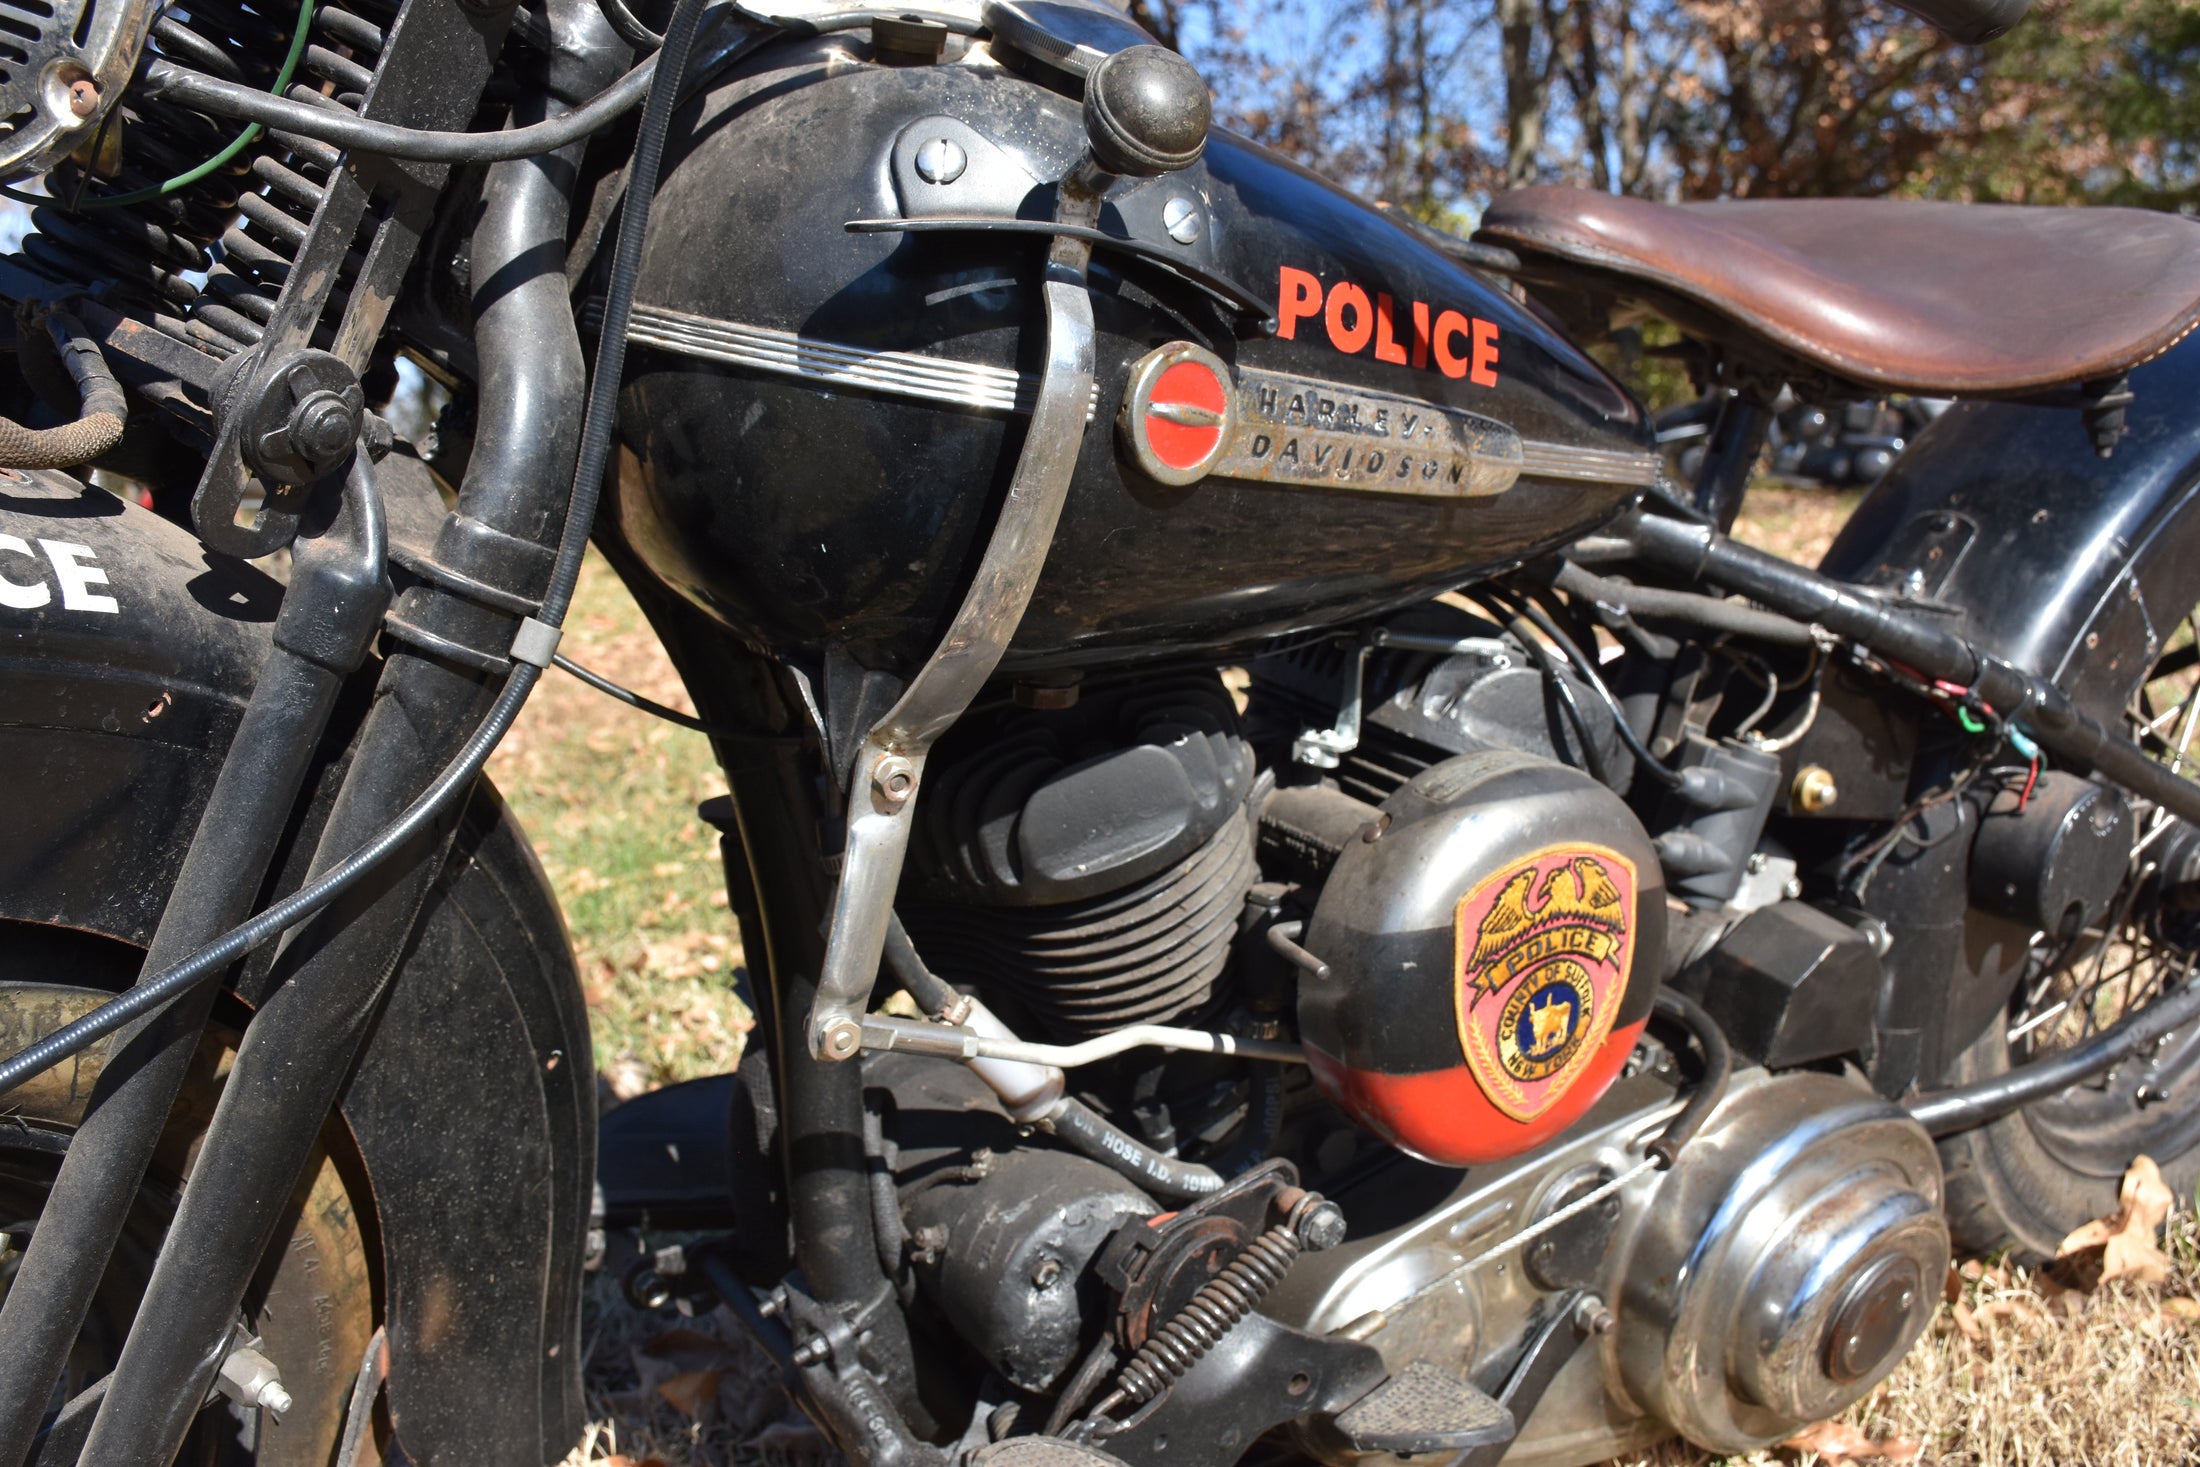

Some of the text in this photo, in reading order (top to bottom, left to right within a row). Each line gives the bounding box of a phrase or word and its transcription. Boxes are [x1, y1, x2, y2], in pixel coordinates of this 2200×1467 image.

[1276, 266, 1499, 387] POLICE
[1252, 434, 1463, 484] DAVIDSON
[1507, 932, 1596, 976] POLICE
[1501, 963, 1591, 1041] COUNTY OF SUFFOLK
[1507, 1038, 1580, 1077] NEW YORK
[1102, 1131, 1143, 1167] HOSE
[1147, 1158, 1172, 1184] I.D.
